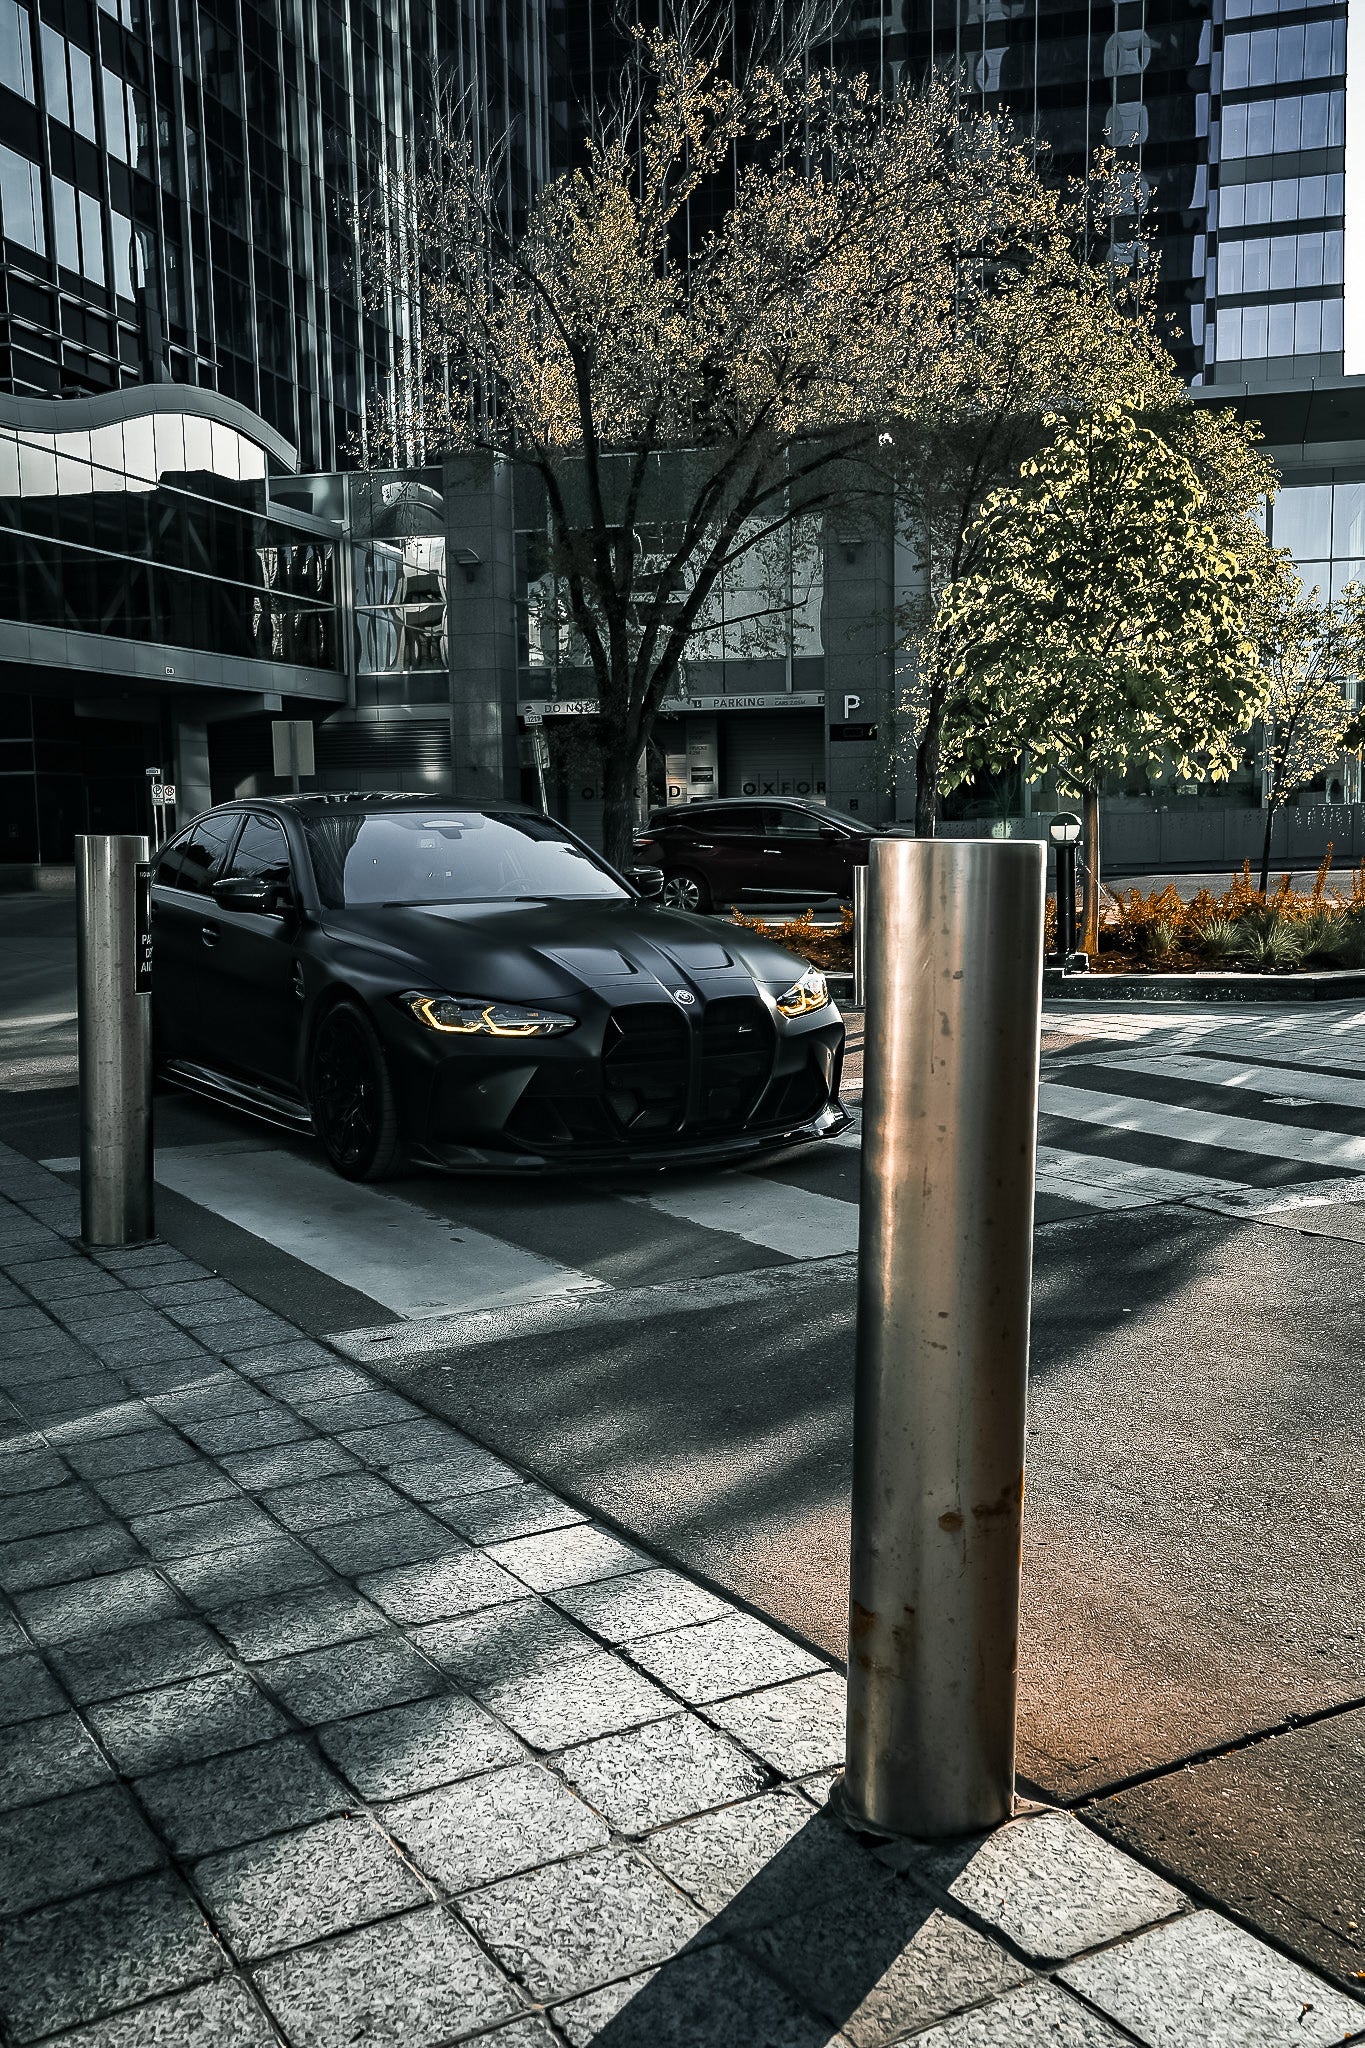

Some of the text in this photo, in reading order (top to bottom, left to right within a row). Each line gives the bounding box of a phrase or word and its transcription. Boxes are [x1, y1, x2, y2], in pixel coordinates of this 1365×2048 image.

[544, 704, 561, 713] DO
[713, 698, 765, 708] PARKING
[844, 695, 861, 719] P
[743, 781, 827, 795] OXFOR
